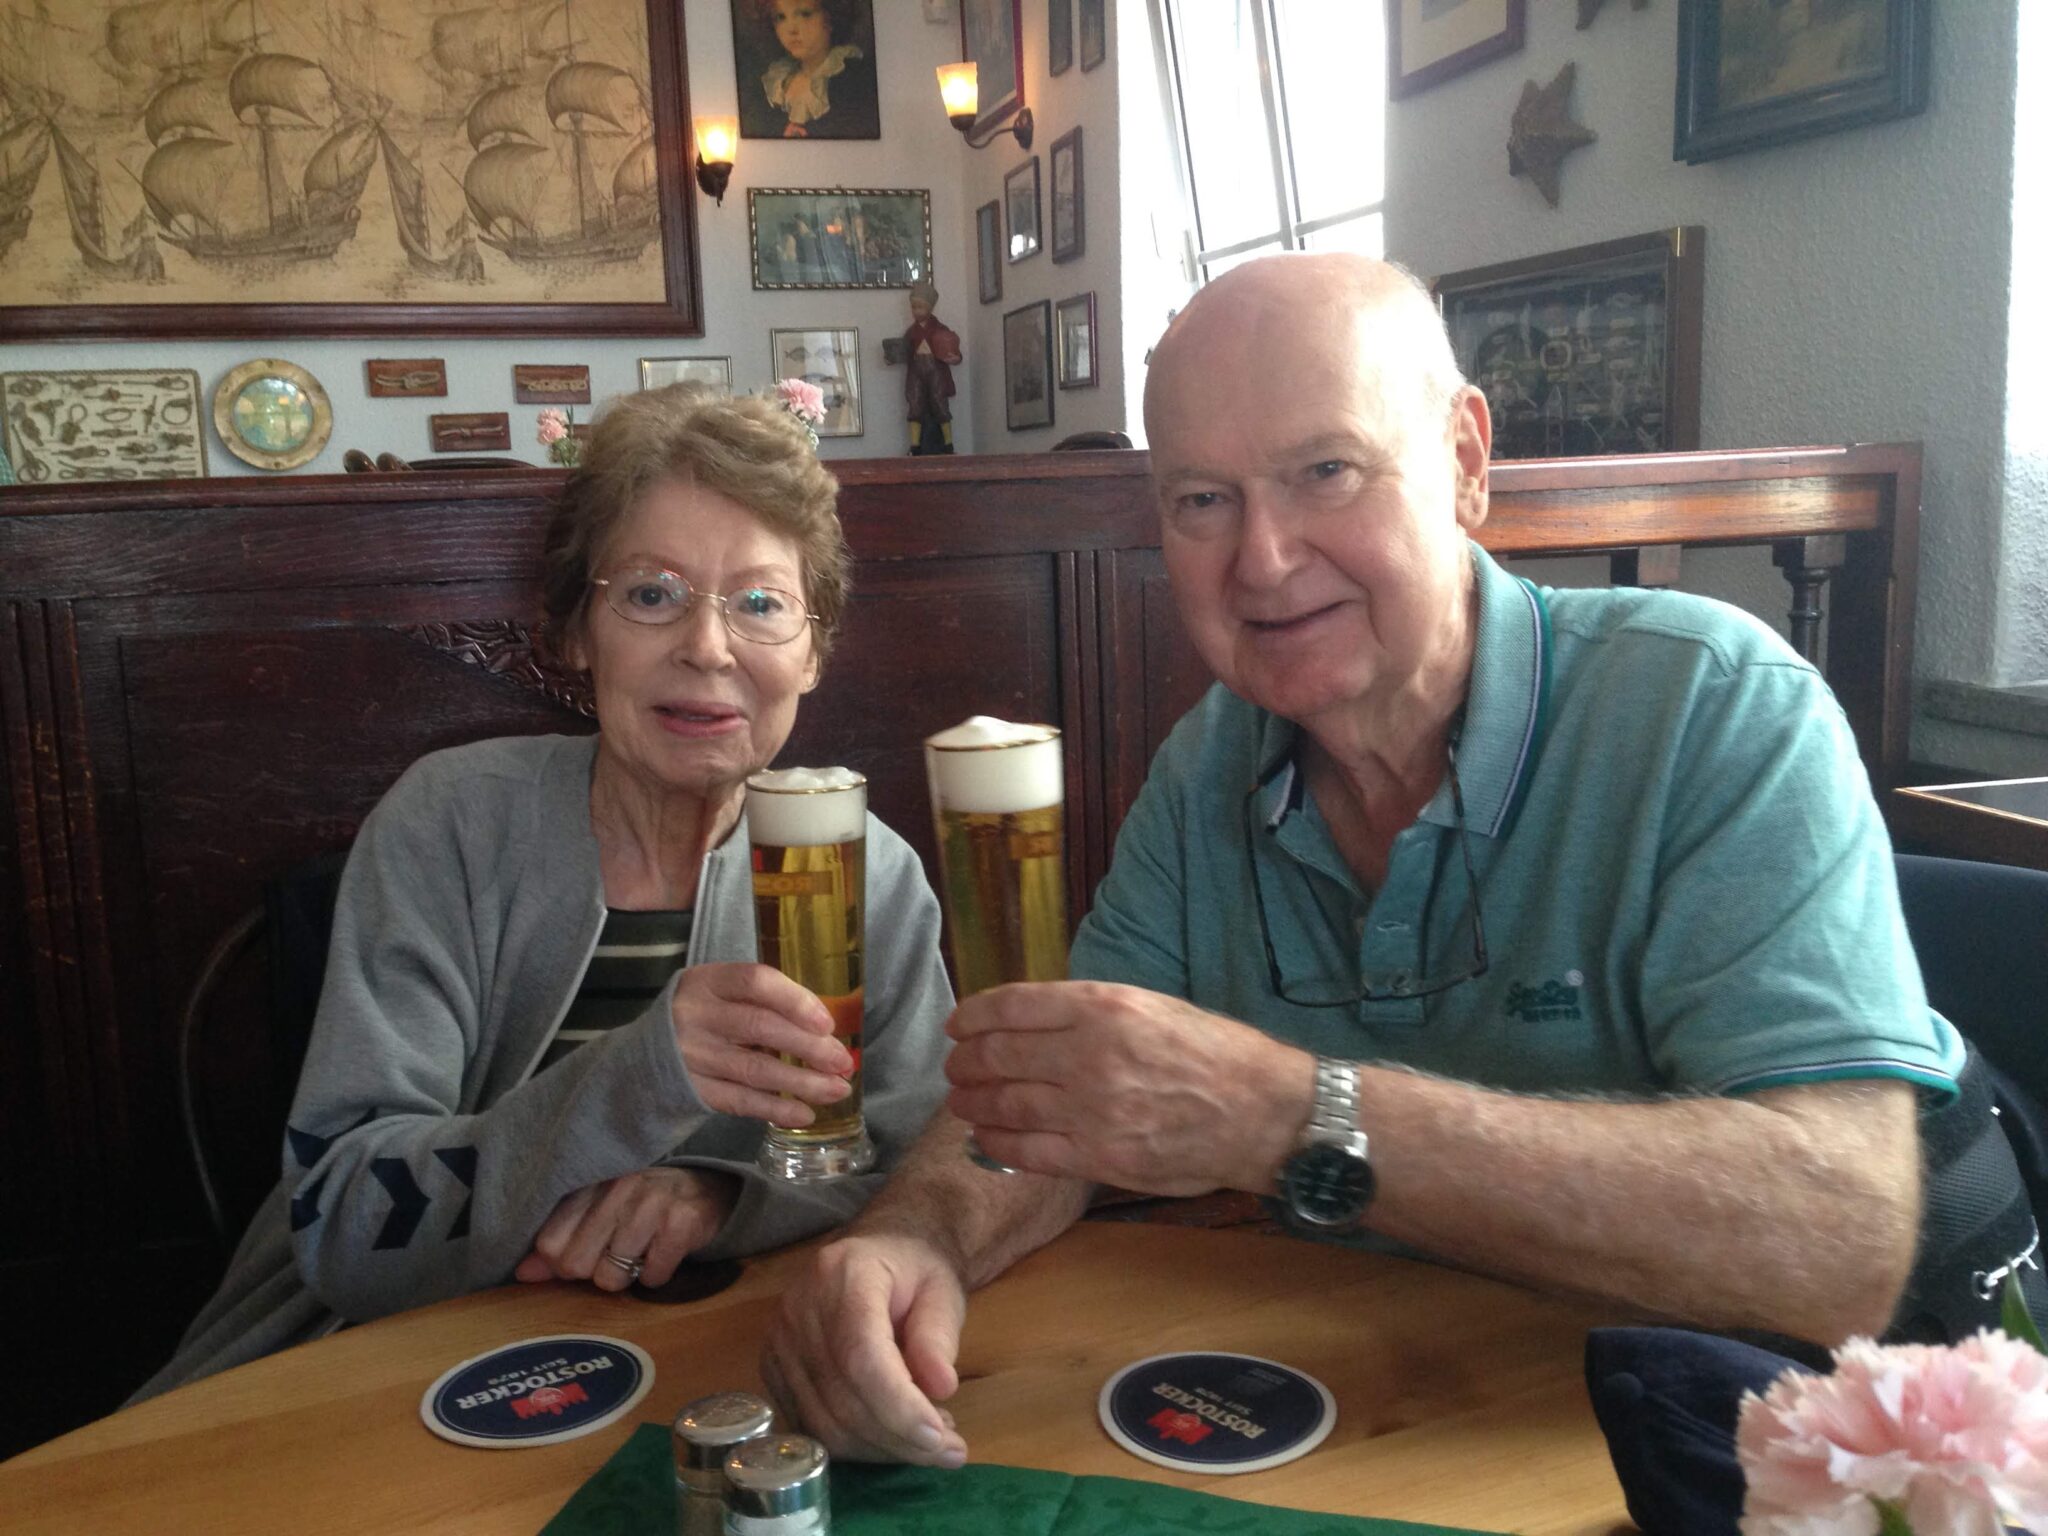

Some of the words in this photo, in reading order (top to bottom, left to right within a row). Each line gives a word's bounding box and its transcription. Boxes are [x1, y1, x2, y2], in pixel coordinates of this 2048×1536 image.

[455, 1356, 614, 1410] ROSTOCKER
[532, 1357, 569, 1372] SEIT
[1152, 1382, 1267, 1439] ROSTOCKER
